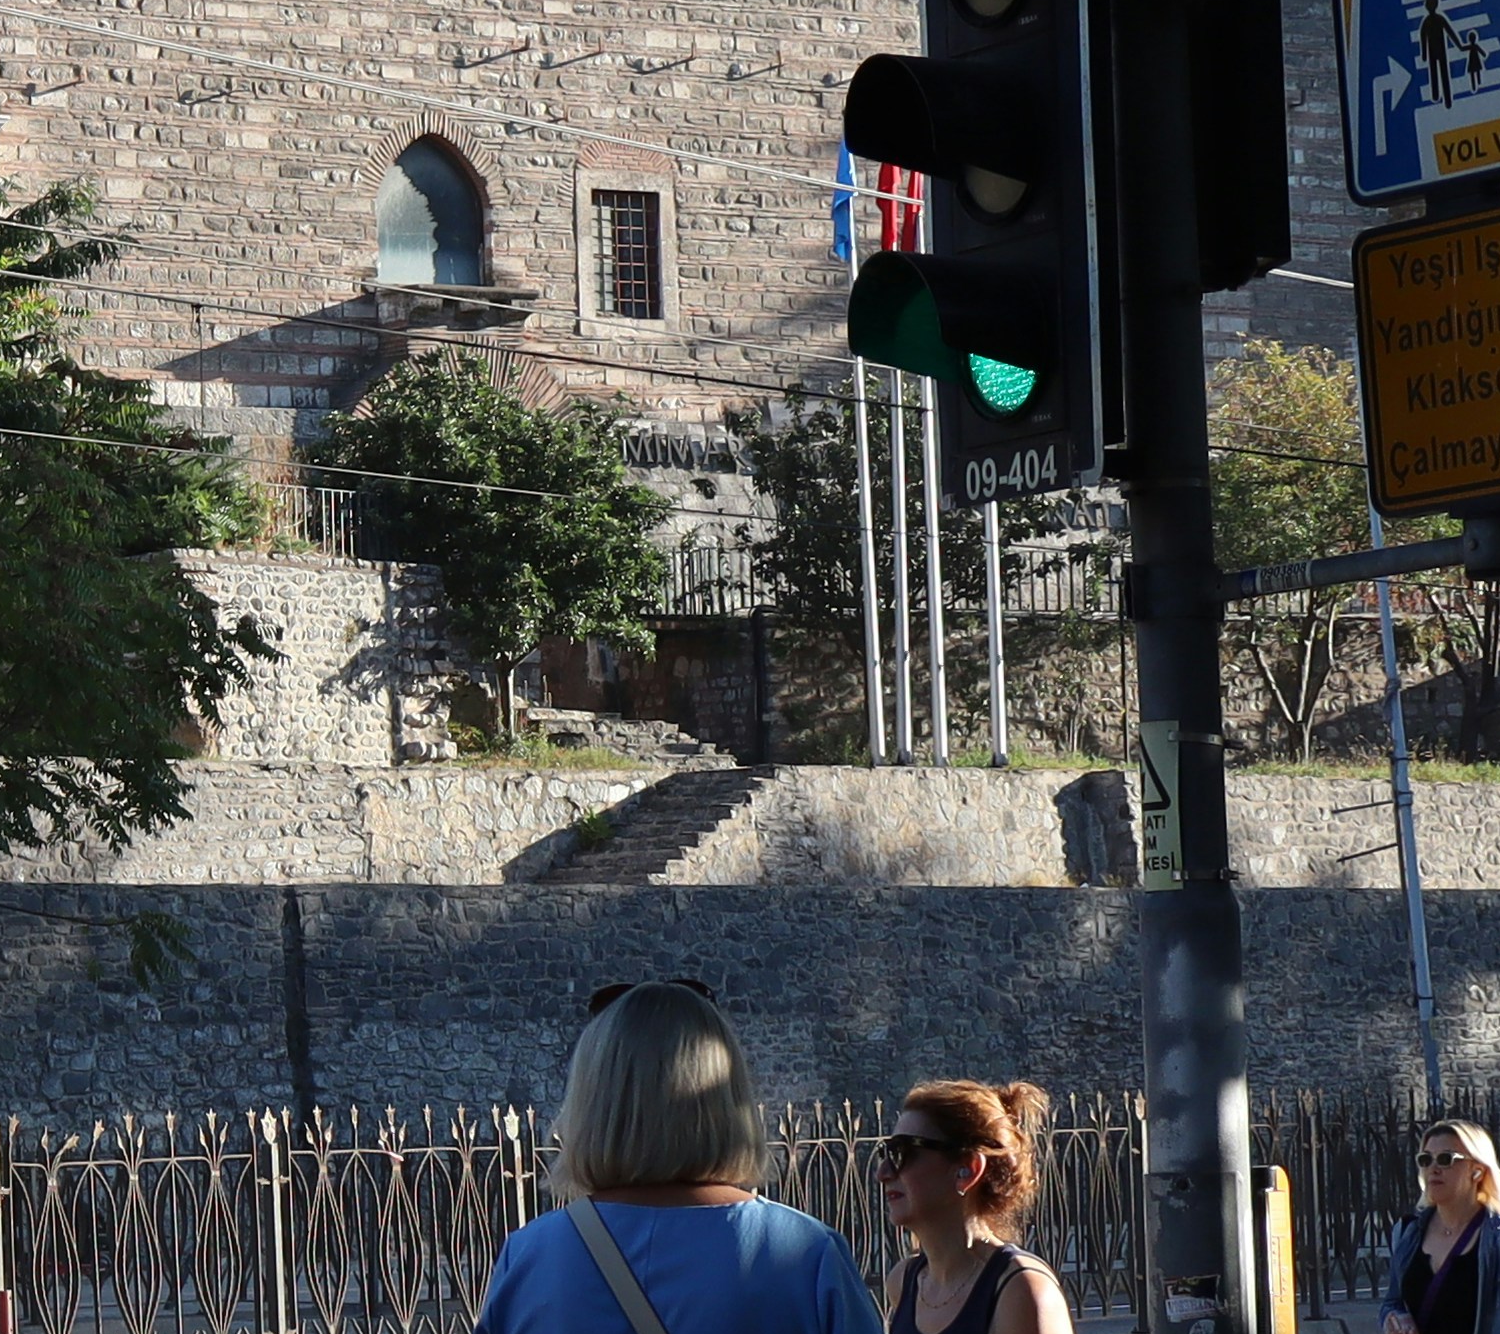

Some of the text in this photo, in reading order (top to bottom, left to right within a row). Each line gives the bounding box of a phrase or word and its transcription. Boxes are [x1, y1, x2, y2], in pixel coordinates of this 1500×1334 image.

[1441, 139, 1488, 167] YOL
[1388, 239, 1464, 291] Yeşil
[965, 444, 1058, 501] 09-404
